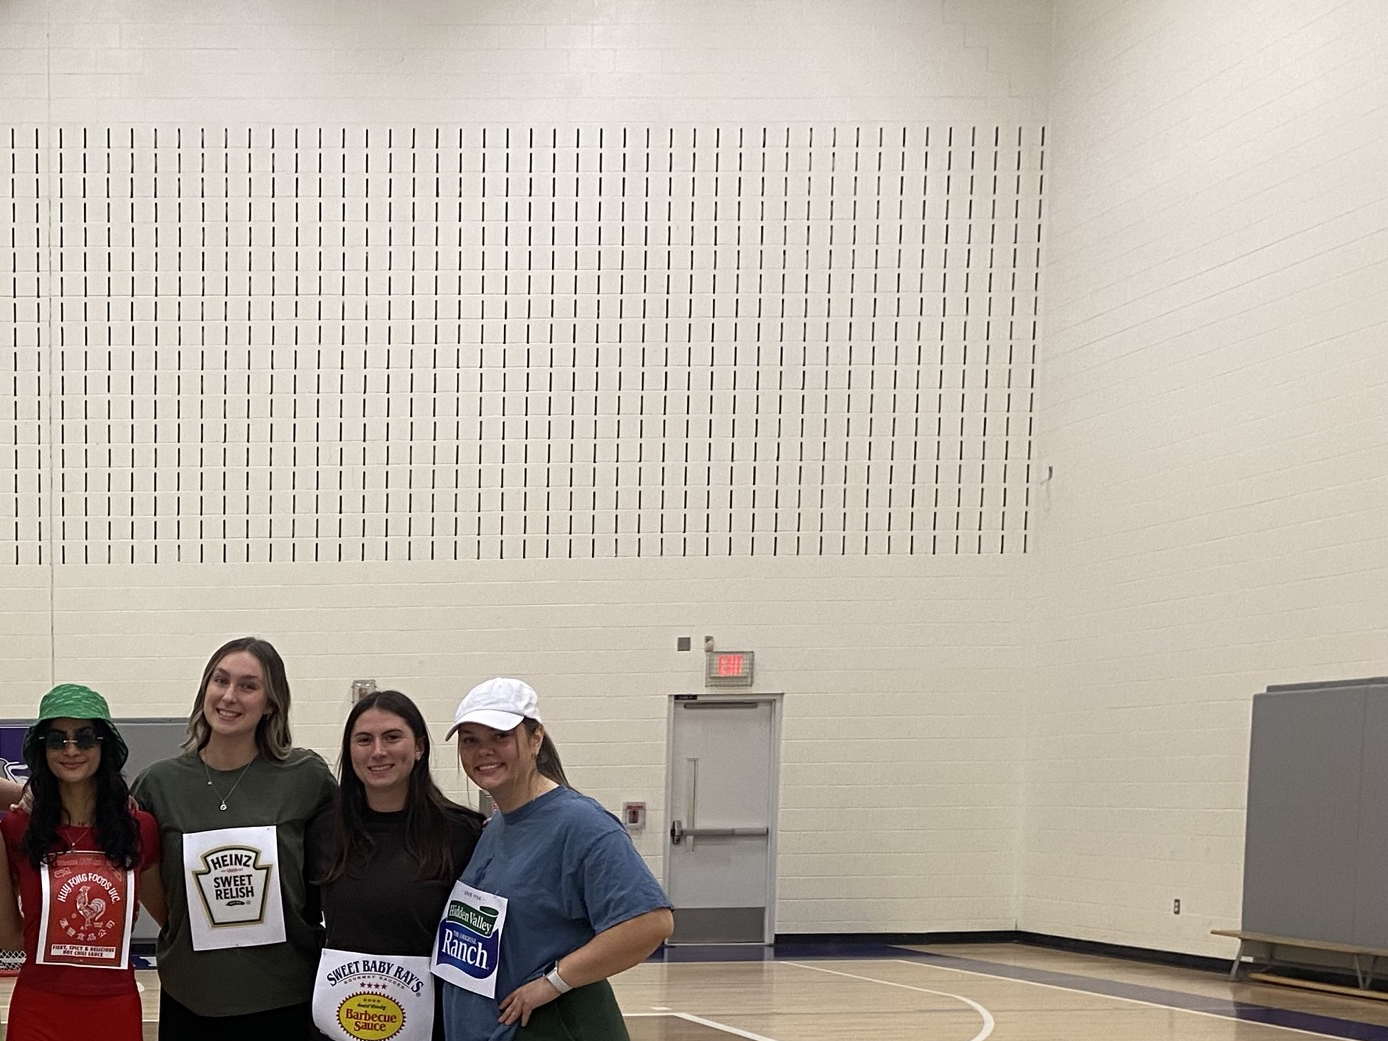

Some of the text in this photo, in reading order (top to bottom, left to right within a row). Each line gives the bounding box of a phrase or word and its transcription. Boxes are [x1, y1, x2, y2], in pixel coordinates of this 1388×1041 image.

[210, 853, 253, 870] HEINZ
[88, 872, 112, 890] FOODS
[213, 874, 253, 888] SWEET
[215, 886, 255, 900] RELISH
[469, 911, 492, 935] Valley
[441, 928, 488, 970] Ranch
[326, 960, 425, 993] SWEET BABY RAY'S
[345, 1008, 397, 1024] Barbecue
[353, 1020, 387, 1032] Sauce
